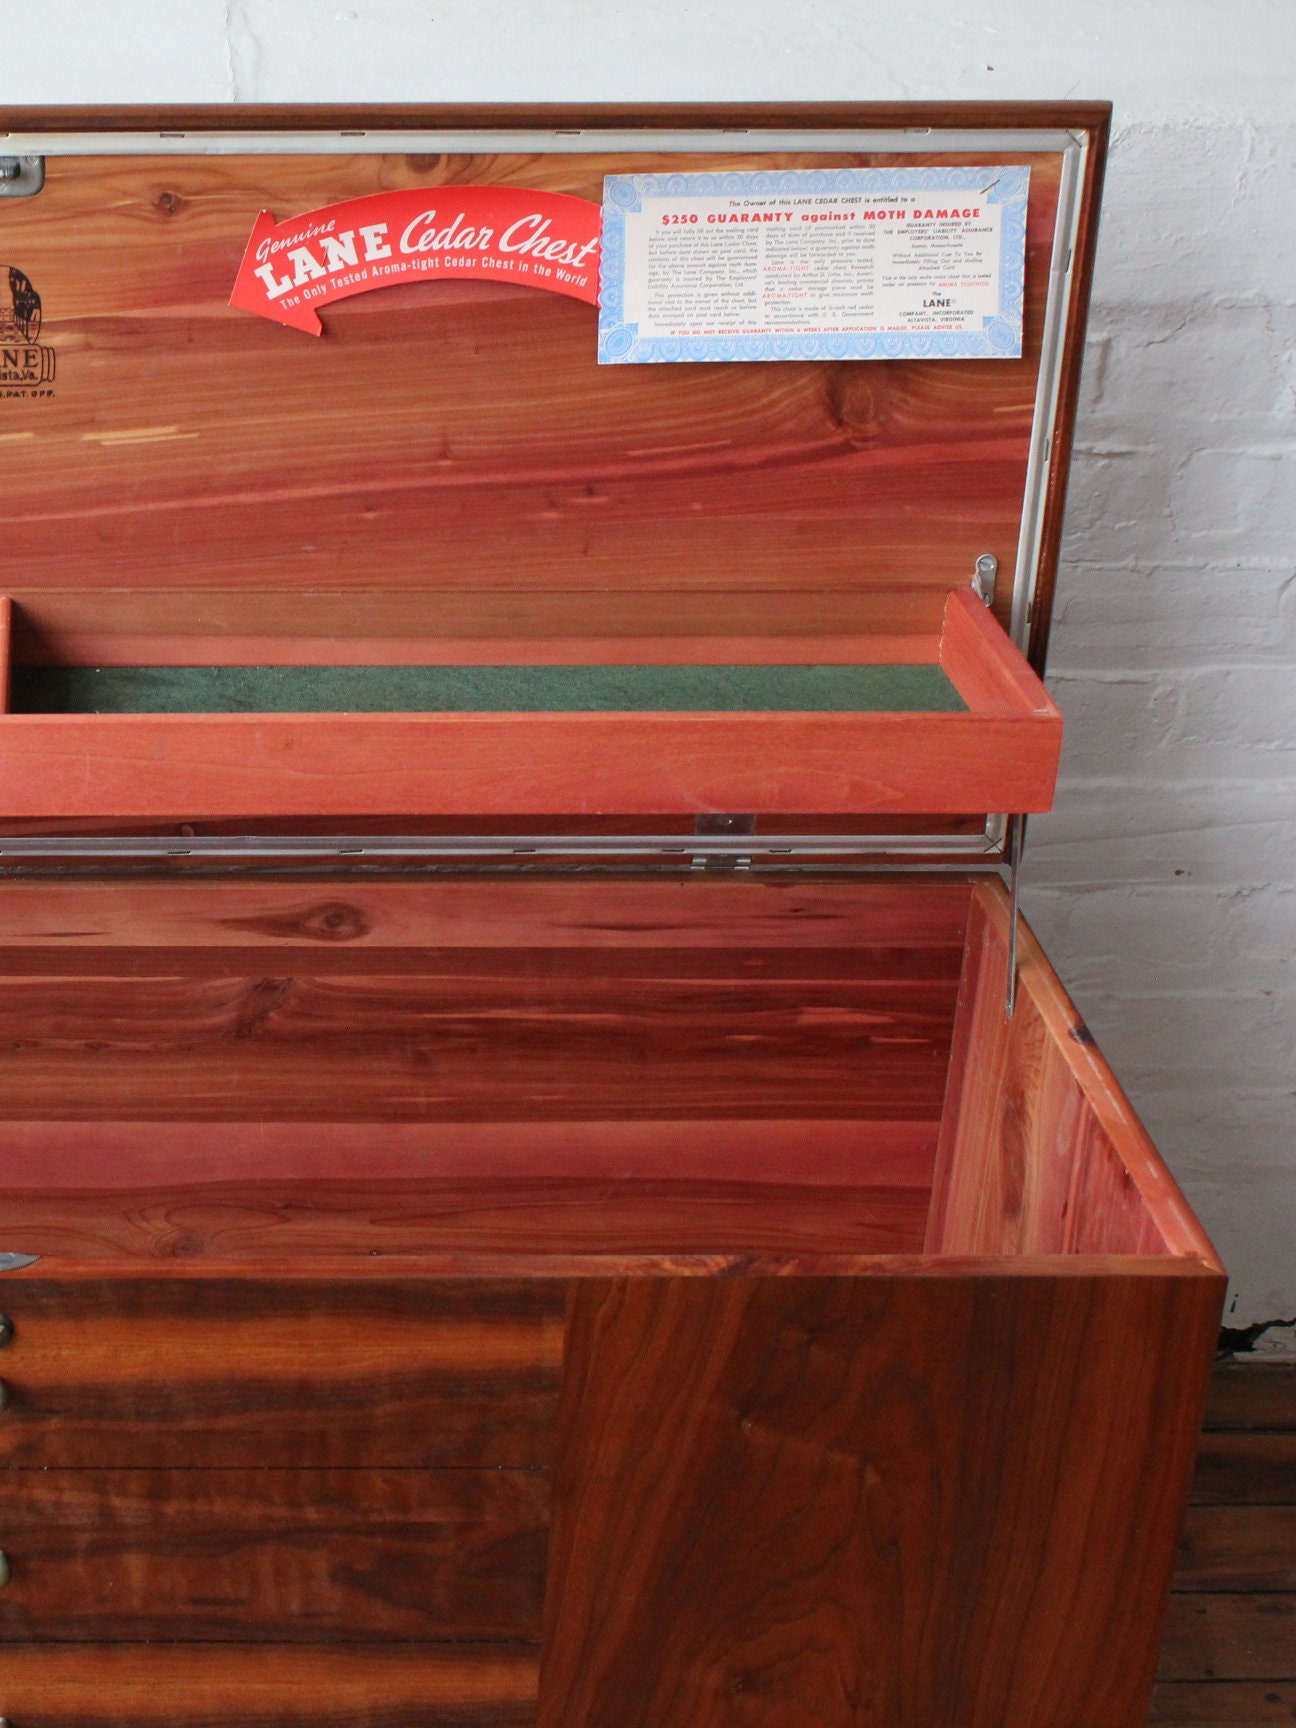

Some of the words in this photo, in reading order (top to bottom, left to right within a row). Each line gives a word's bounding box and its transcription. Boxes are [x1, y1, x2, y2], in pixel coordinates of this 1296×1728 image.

[662, 214, 698, 226] $250
[707, 212, 793, 223] GUARANTY
[802, 211, 855, 223] against
[863, 210, 905, 220] MOTH
[914, 208, 980, 219] DAMAGE
[254, 223, 392, 300] LANE
[399, 210, 492, 253] Cedar
[498, 214, 598, 268] Chest
[256, 219, 336, 261] Genuine
[280, 296, 300, 310] The
[303, 284, 328, 300] Only
[330, 270, 368, 289] Tested
[372, 258, 440, 277] Aroma-tight
[445, 256, 477, 268] Cedar
[481, 257, 514, 269] Chest
[518, 261, 529, 272] in
[533, 262, 552, 277] the
[555, 268, 588, 287] World
[923, 299, 951, 308] LANE
